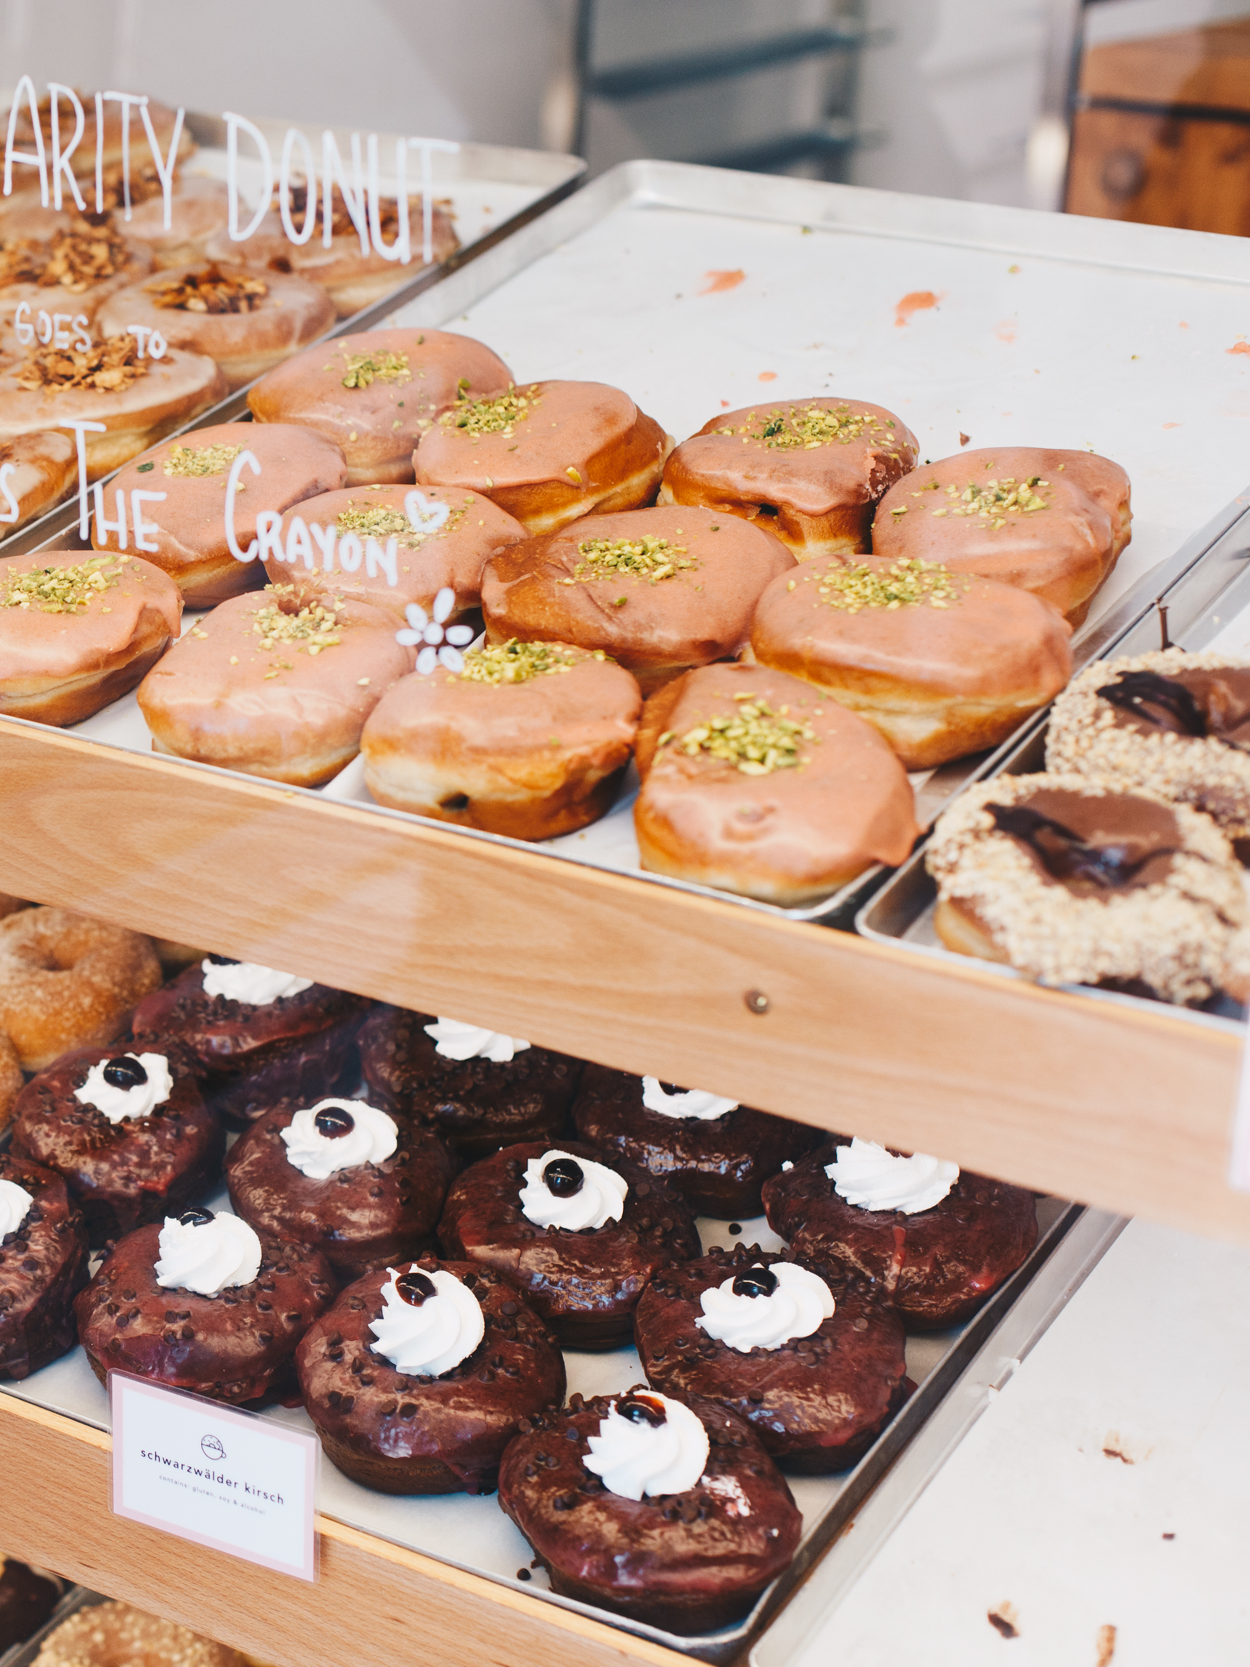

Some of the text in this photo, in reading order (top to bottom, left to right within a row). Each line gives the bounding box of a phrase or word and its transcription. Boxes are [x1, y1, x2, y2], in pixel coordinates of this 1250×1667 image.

[222, 111, 461, 265] DONUT
[14, 301, 93, 353] GOES
[126, 324, 168, 360] TO
[58, 419, 168, 554] THE
[140, 1449, 284, 1505] schwarzwälder kirsch
[219, 1495, 230, 1504] soy
